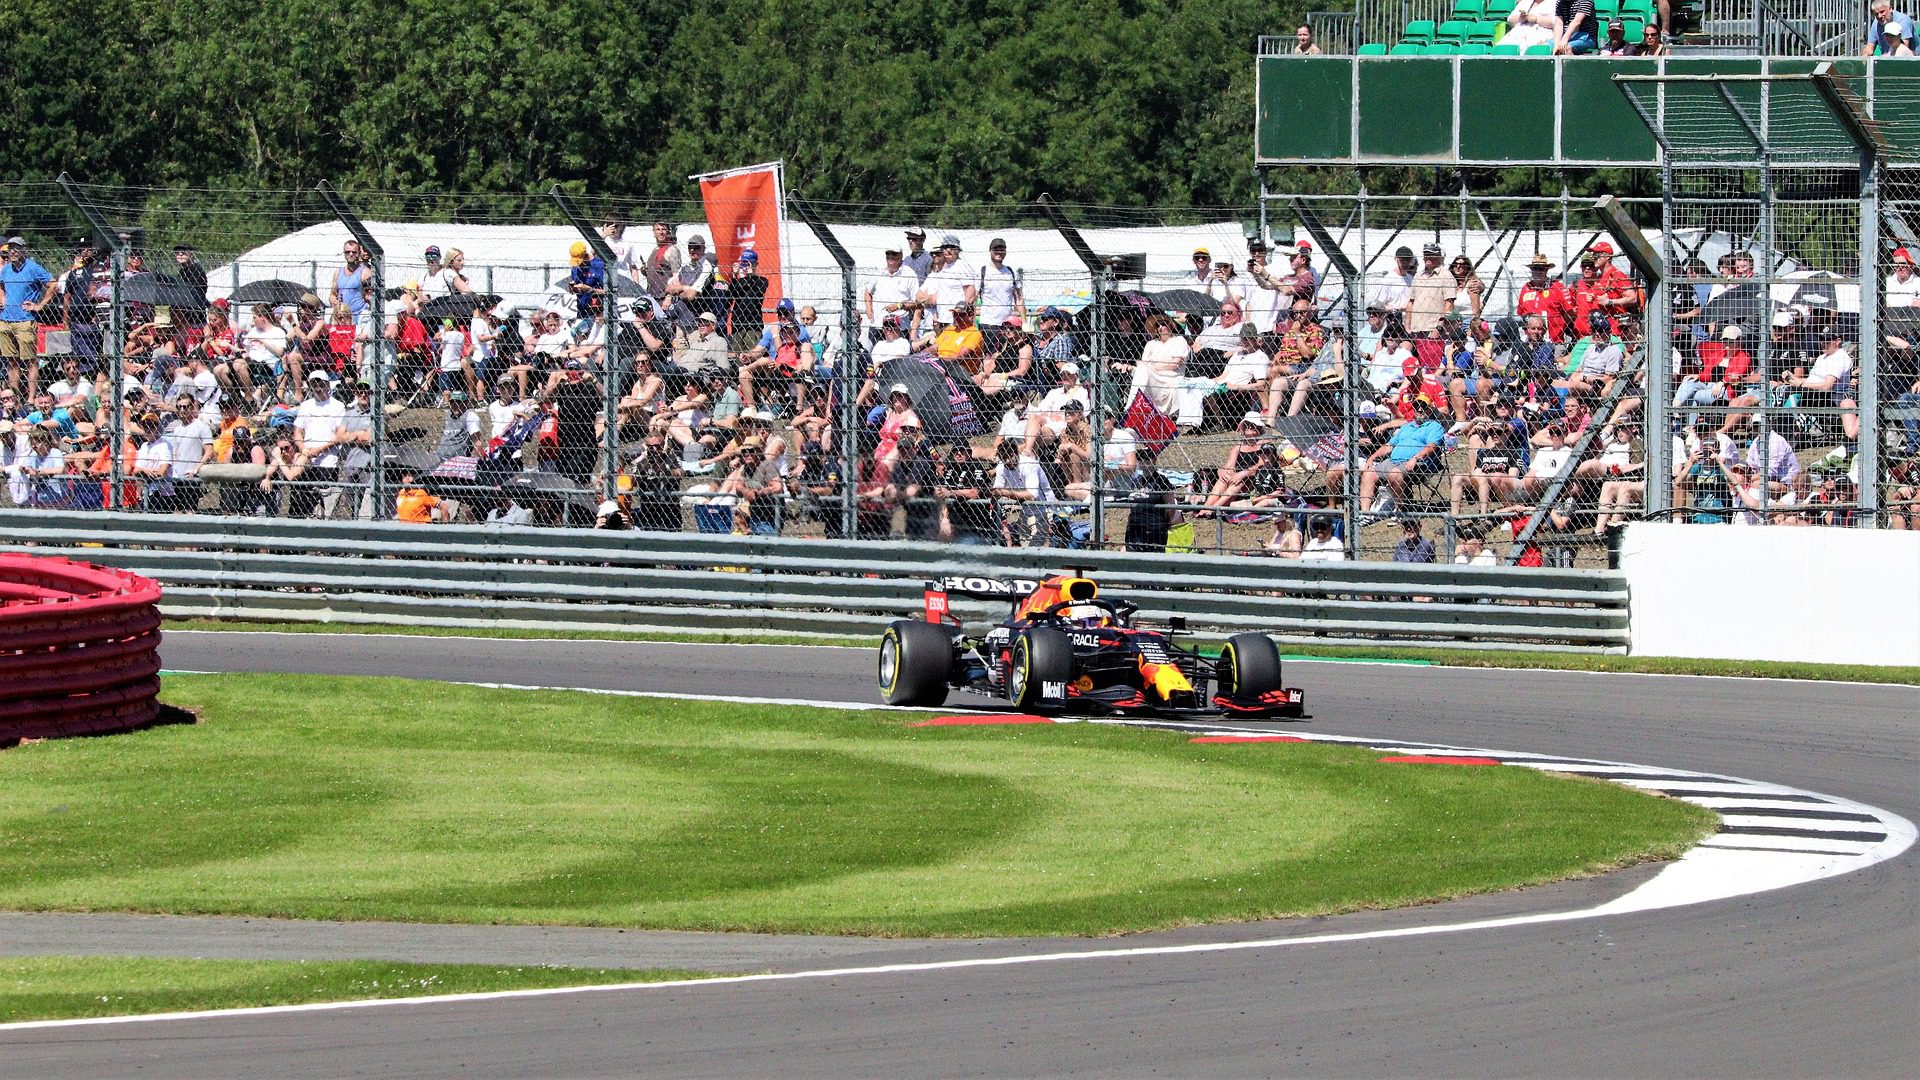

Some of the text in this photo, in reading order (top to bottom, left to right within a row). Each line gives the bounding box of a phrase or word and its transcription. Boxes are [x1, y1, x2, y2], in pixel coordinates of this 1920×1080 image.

[945, 576, 1038, 594] HOND
[929, 596, 945, 611] ESSO
[1042, 680, 1061, 699] Mobil
